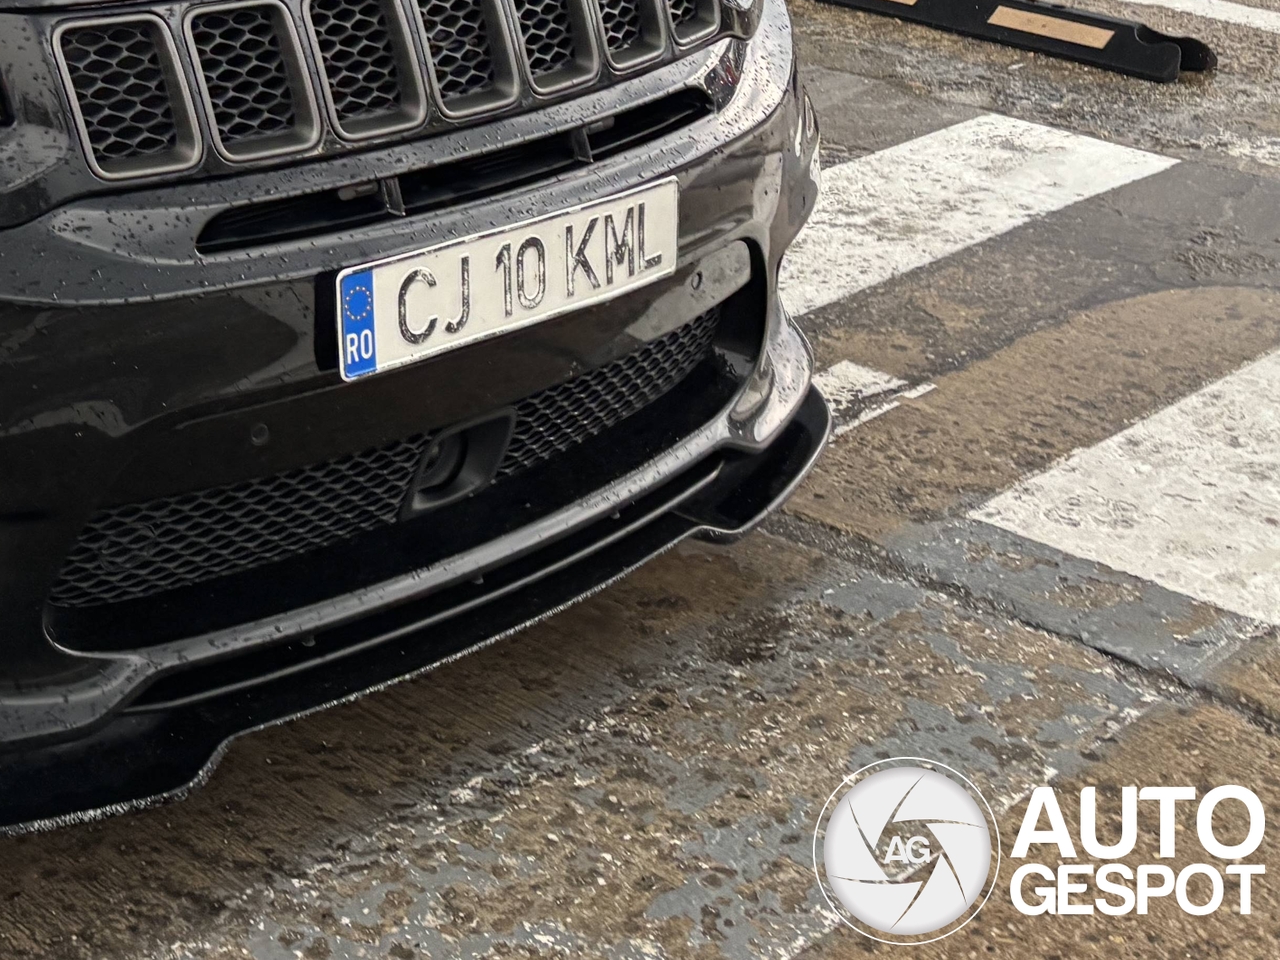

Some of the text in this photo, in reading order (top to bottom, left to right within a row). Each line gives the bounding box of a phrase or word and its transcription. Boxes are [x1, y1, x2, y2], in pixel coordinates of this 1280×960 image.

[397, 200, 663, 346] CJ 10 KML
[345, 329, 374, 365] RO
